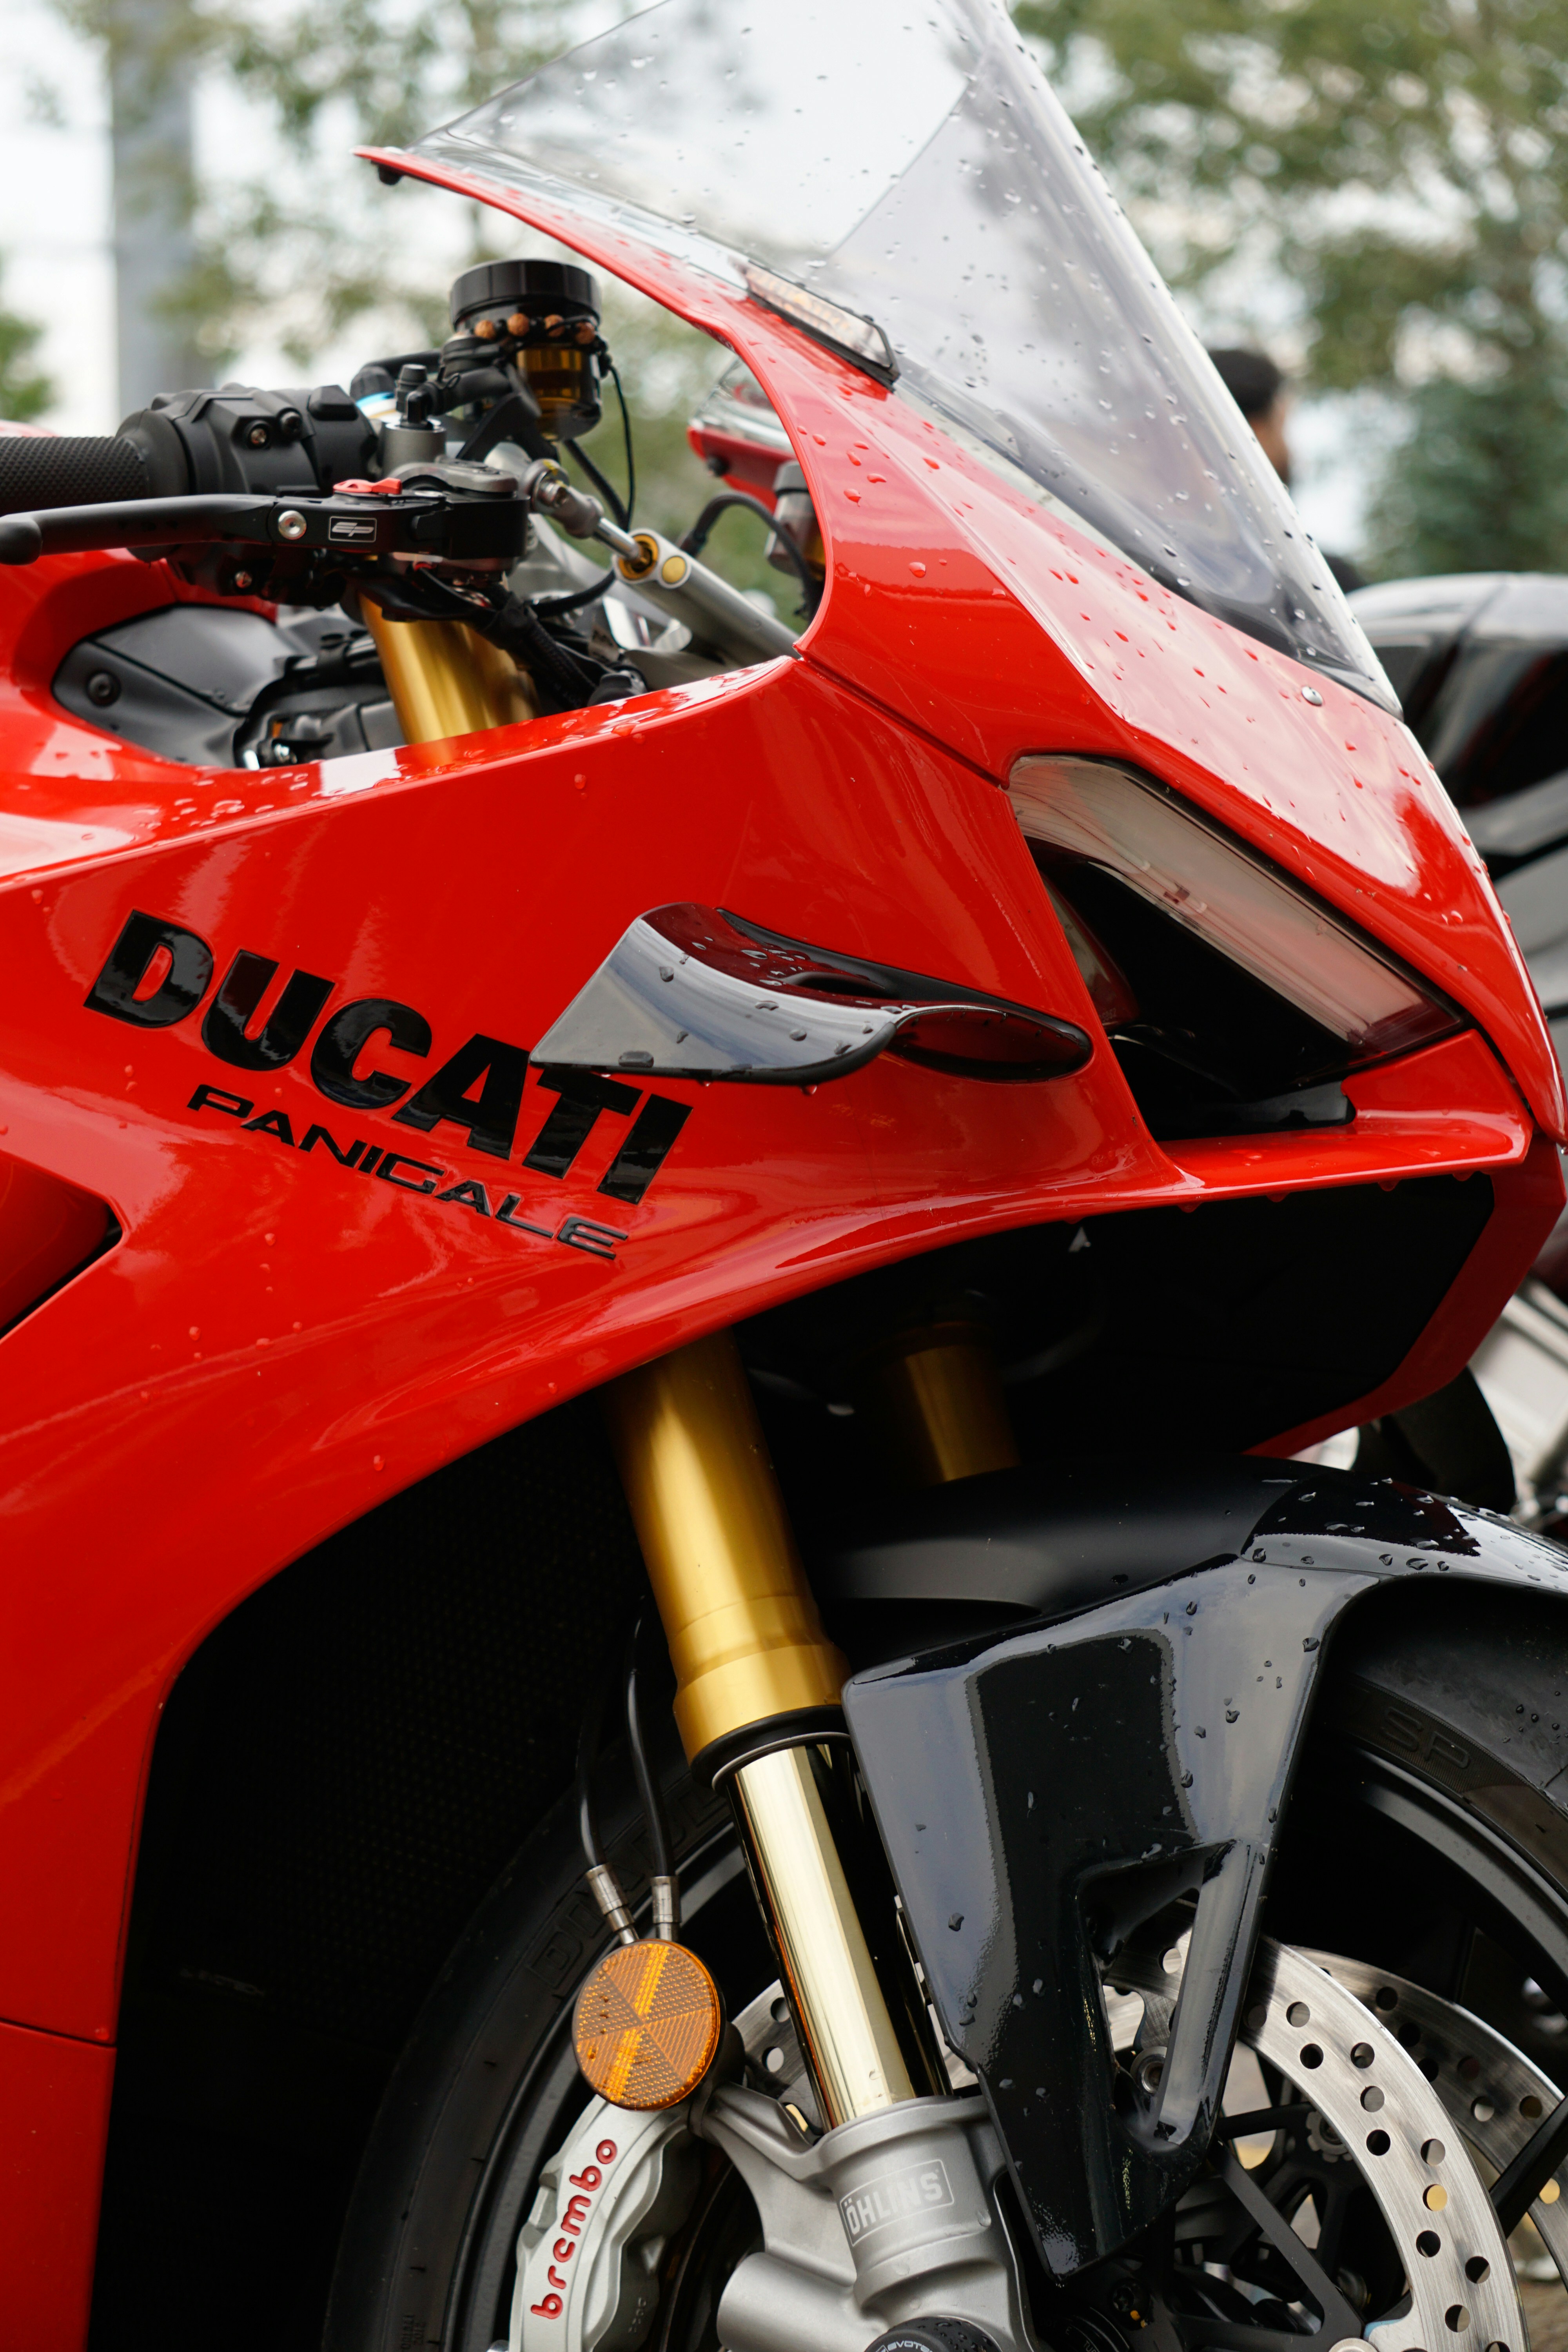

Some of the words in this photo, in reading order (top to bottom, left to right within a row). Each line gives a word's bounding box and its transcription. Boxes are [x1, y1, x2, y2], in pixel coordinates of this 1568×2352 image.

[83, 909, 693, 1205] DUCATI
[187, 1083, 629, 1260] PANIGALE
[530, 2139, 617, 2319] brembo
[844, 2172, 943, 2235] ÖHLINS
[887, 2340, 934, 2352] EVOTE
